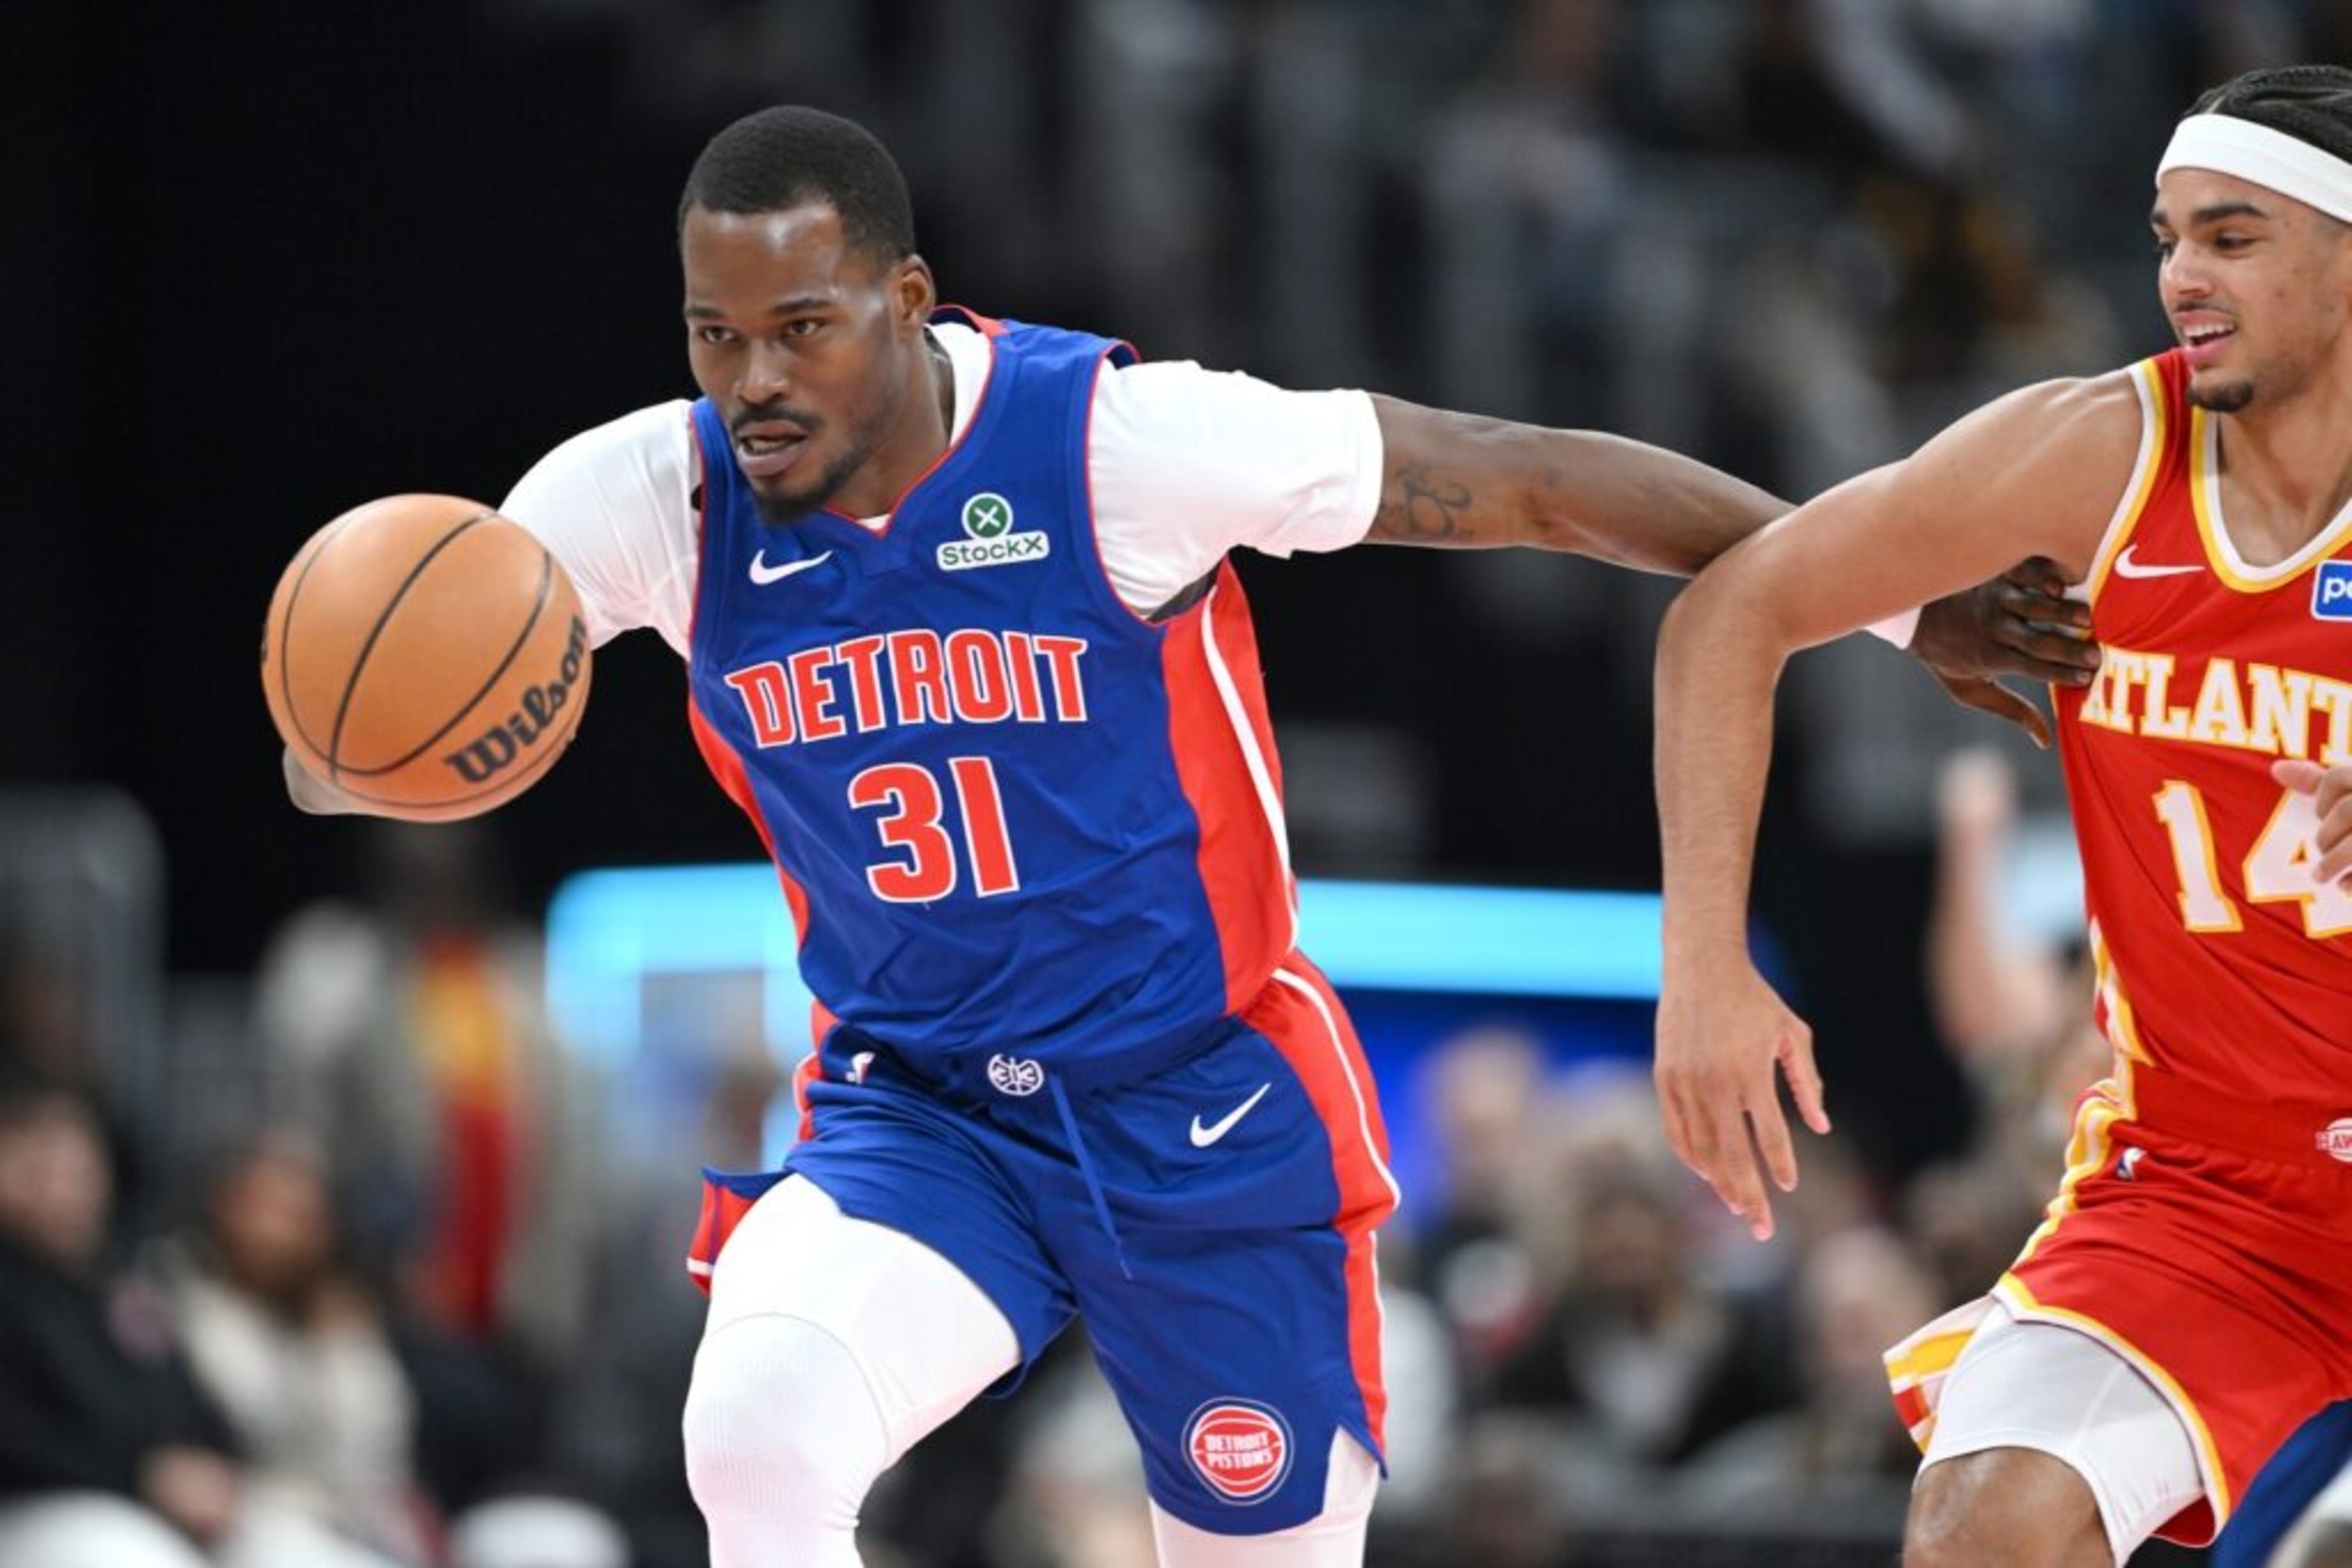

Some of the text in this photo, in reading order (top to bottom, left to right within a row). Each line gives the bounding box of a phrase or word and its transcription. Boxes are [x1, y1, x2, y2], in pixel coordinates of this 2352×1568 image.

[942, 534, 1043, 565] StockX
[2324, 577, 2352, 604] p
[444, 614, 587, 783] Wilson
[724, 629, 1088, 749] DETROIT
[848, 756, 1020, 903] 31
[2153, 780, 2352, 939] 14
